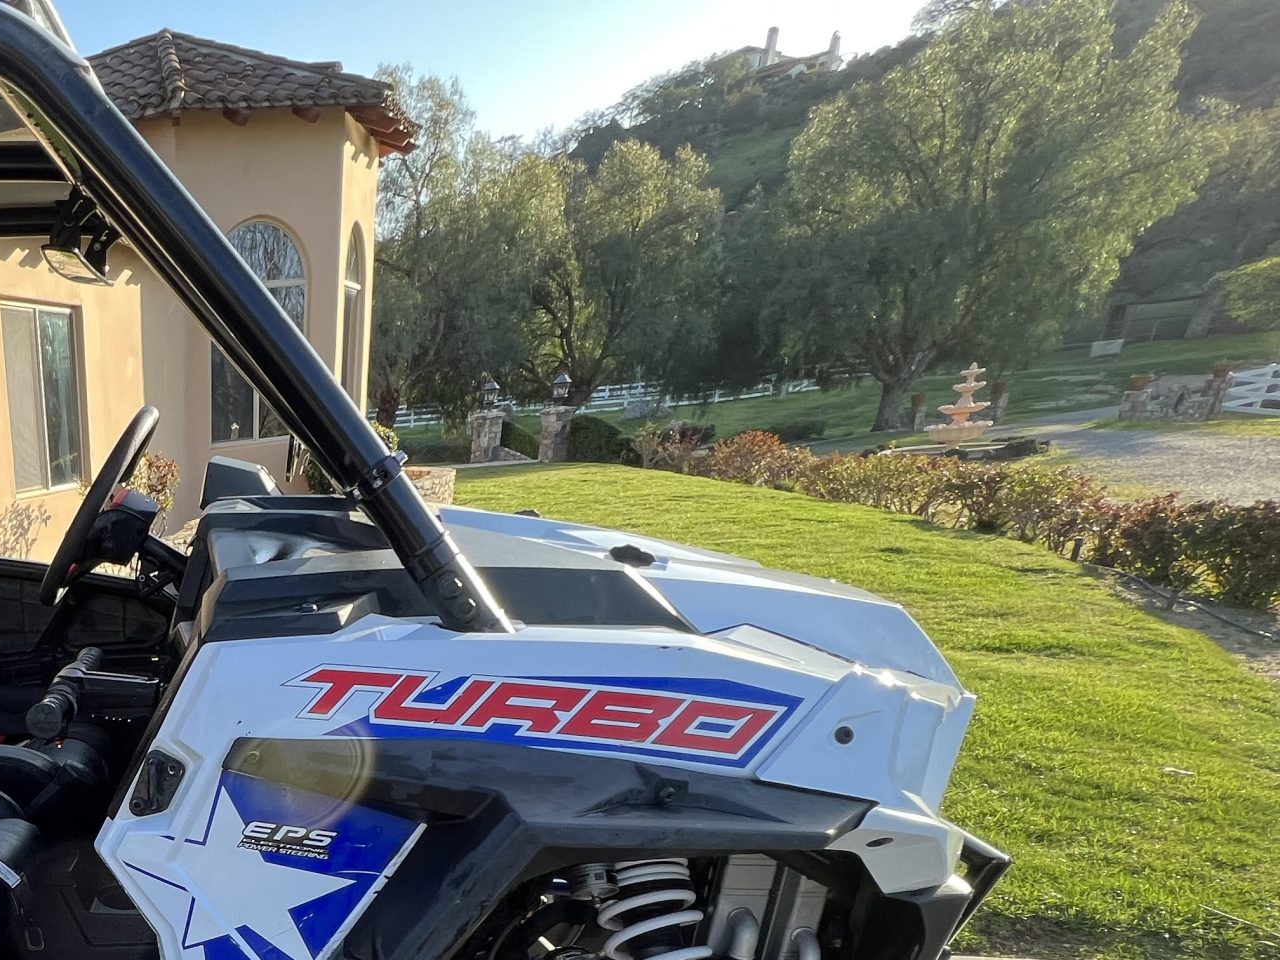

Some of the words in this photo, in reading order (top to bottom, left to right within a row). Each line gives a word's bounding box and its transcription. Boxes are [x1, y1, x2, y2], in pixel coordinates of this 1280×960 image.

[302, 667, 774, 754] TURBO
[243, 821, 338, 847] EPS
[238, 842, 279, 853] POWER
[279, 848, 329, 860] STEERING
[242, 838, 329, 854] ELECTRONIC
